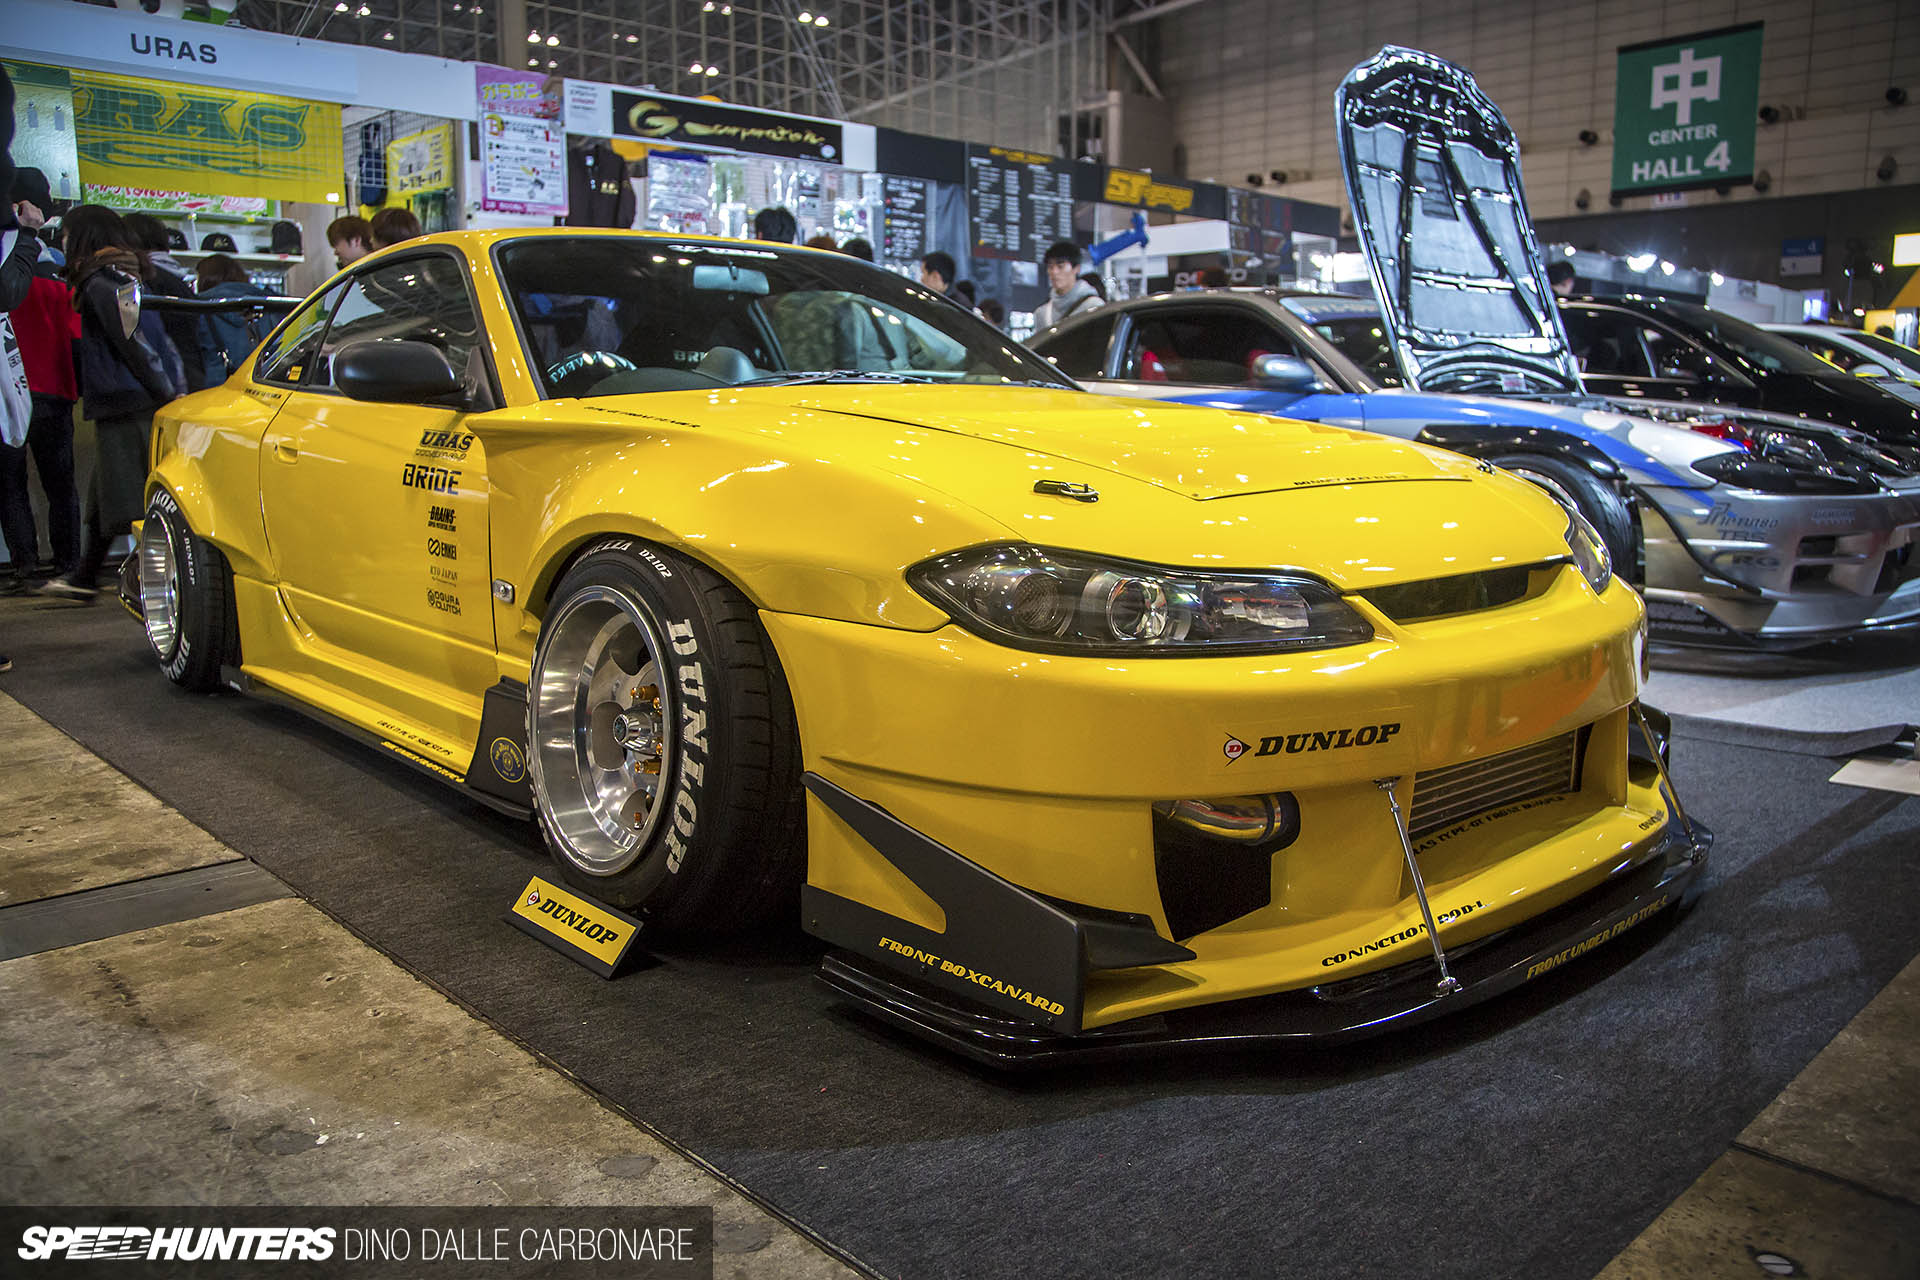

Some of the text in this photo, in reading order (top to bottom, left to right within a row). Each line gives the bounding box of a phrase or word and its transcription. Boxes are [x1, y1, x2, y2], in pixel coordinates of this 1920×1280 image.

[130, 33, 218, 64] URAS
[1650, 48, 1722, 126] 中
[1648, 124, 1718, 146] CENTER
[1632, 141, 1731, 182] HALL 4
[420, 430, 475, 452] URAS
[638, 548, 673, 579] DZ102
[664, 618, 709, 874] DUNLOP
[1254, 723, 1400, 757] DUNLOP
[538, 898, 619, 944] DUNLOP
[1526, 948, 1571, 981] FRONT
[1570, 928, 1610, 958] UNDER
[878, 937, 1065, 1016] FRONT BOXCANARD
